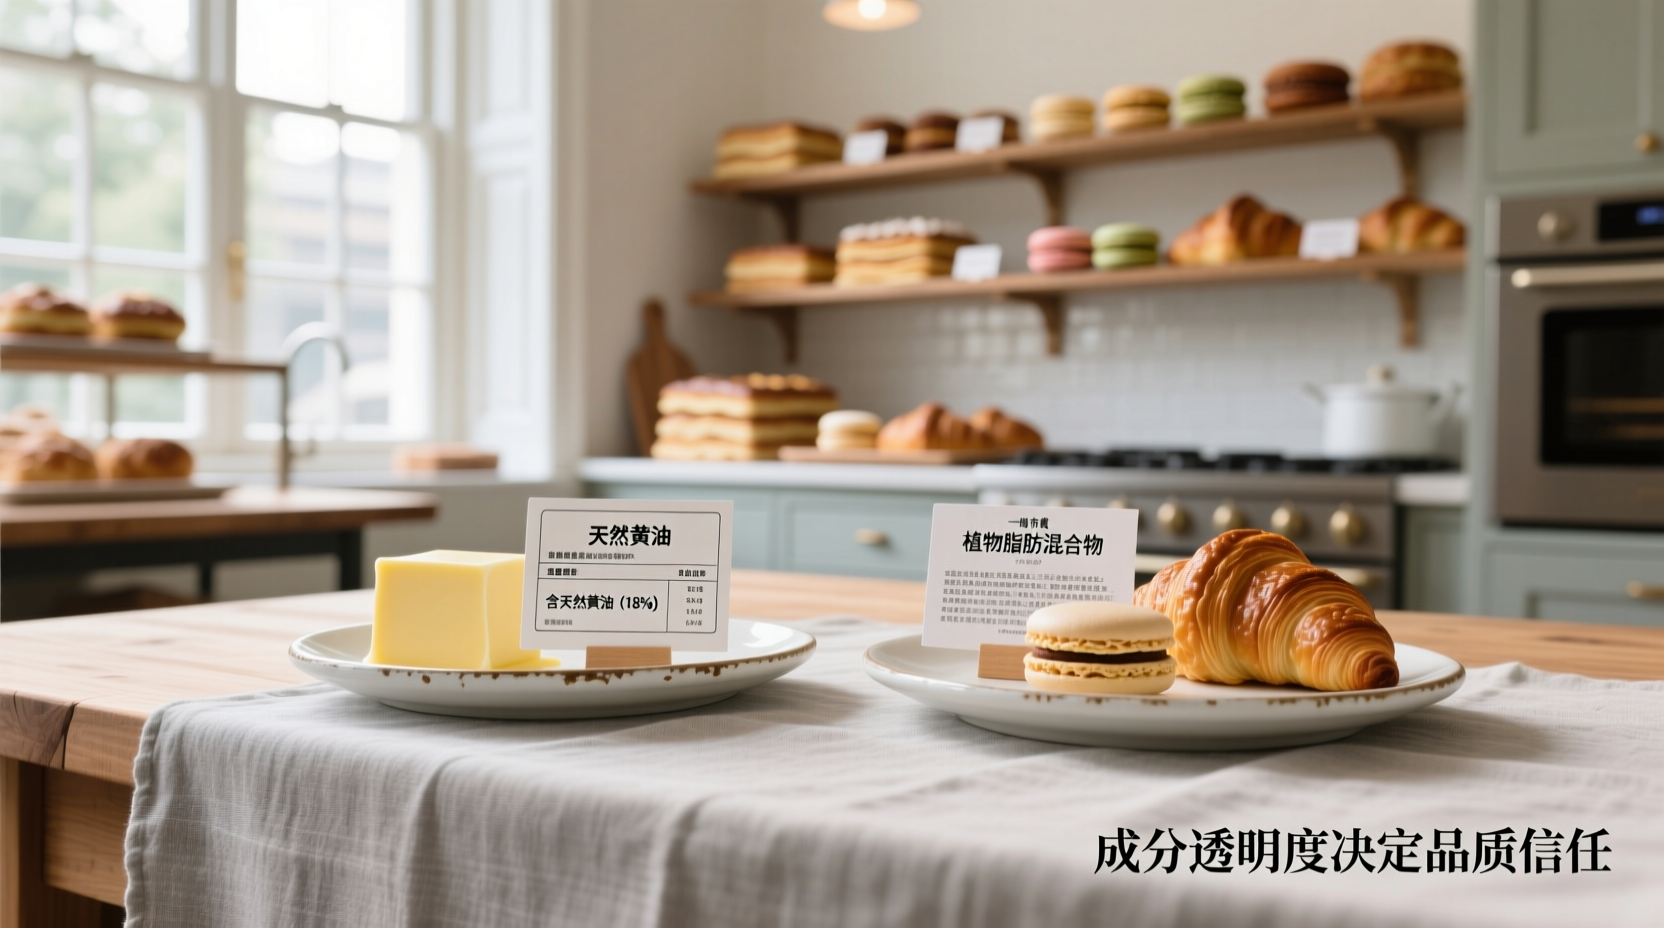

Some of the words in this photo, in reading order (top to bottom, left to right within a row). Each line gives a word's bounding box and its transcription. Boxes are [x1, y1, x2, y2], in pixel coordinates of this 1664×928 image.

[588, 524, 671, 546] 天然黄油
[962, 530, 1104, 556] 植物脂肪混合物
